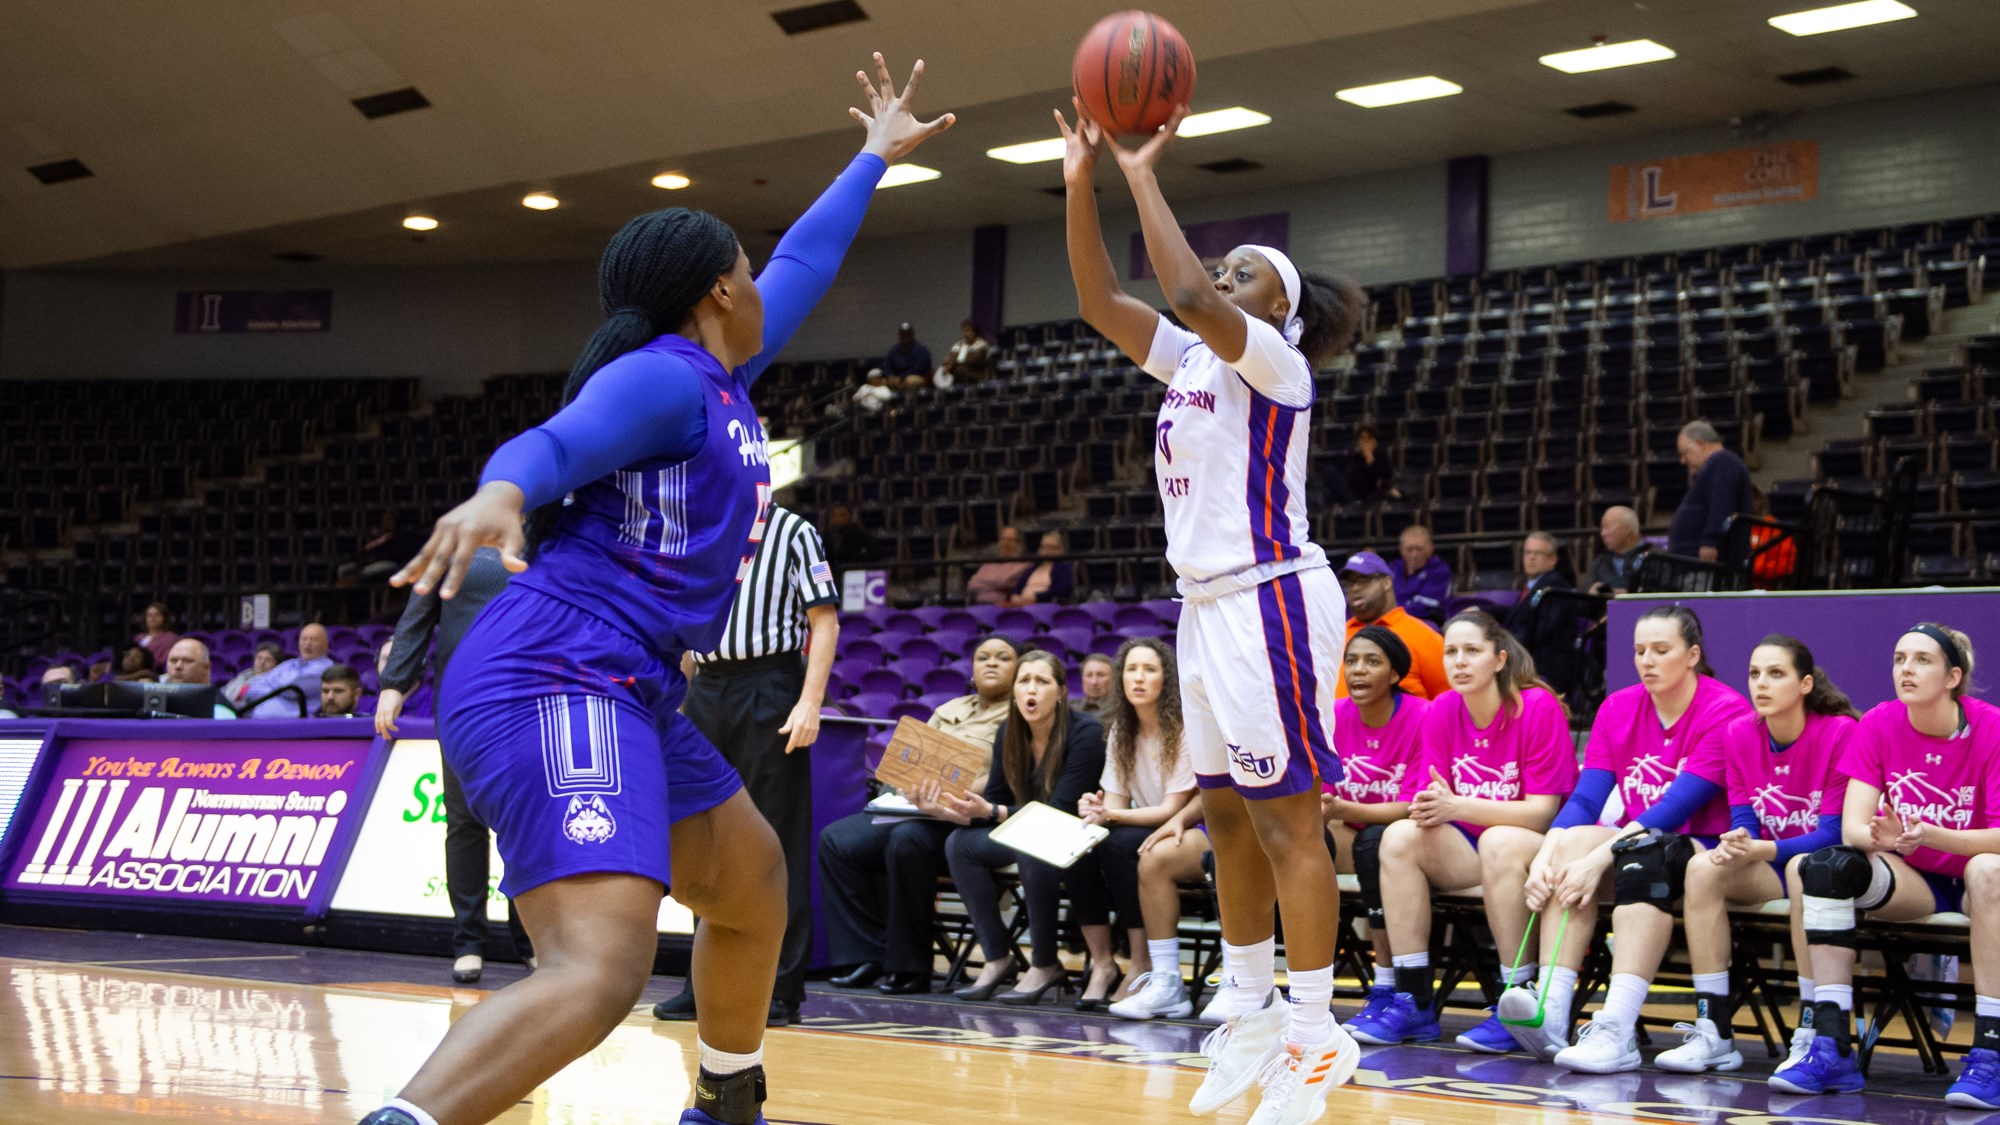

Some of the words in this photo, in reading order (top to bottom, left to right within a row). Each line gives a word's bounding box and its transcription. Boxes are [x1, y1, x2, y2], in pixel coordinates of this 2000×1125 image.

[1641, 166, 1678, 217] L
[866, 577, 886, 605] C
[242, 601, 253, 624] B
[237, 758, 263, 780] A
[103, 787, 348, 867] Alumni
[90, 860, 317, 900] ASSOCIATION
